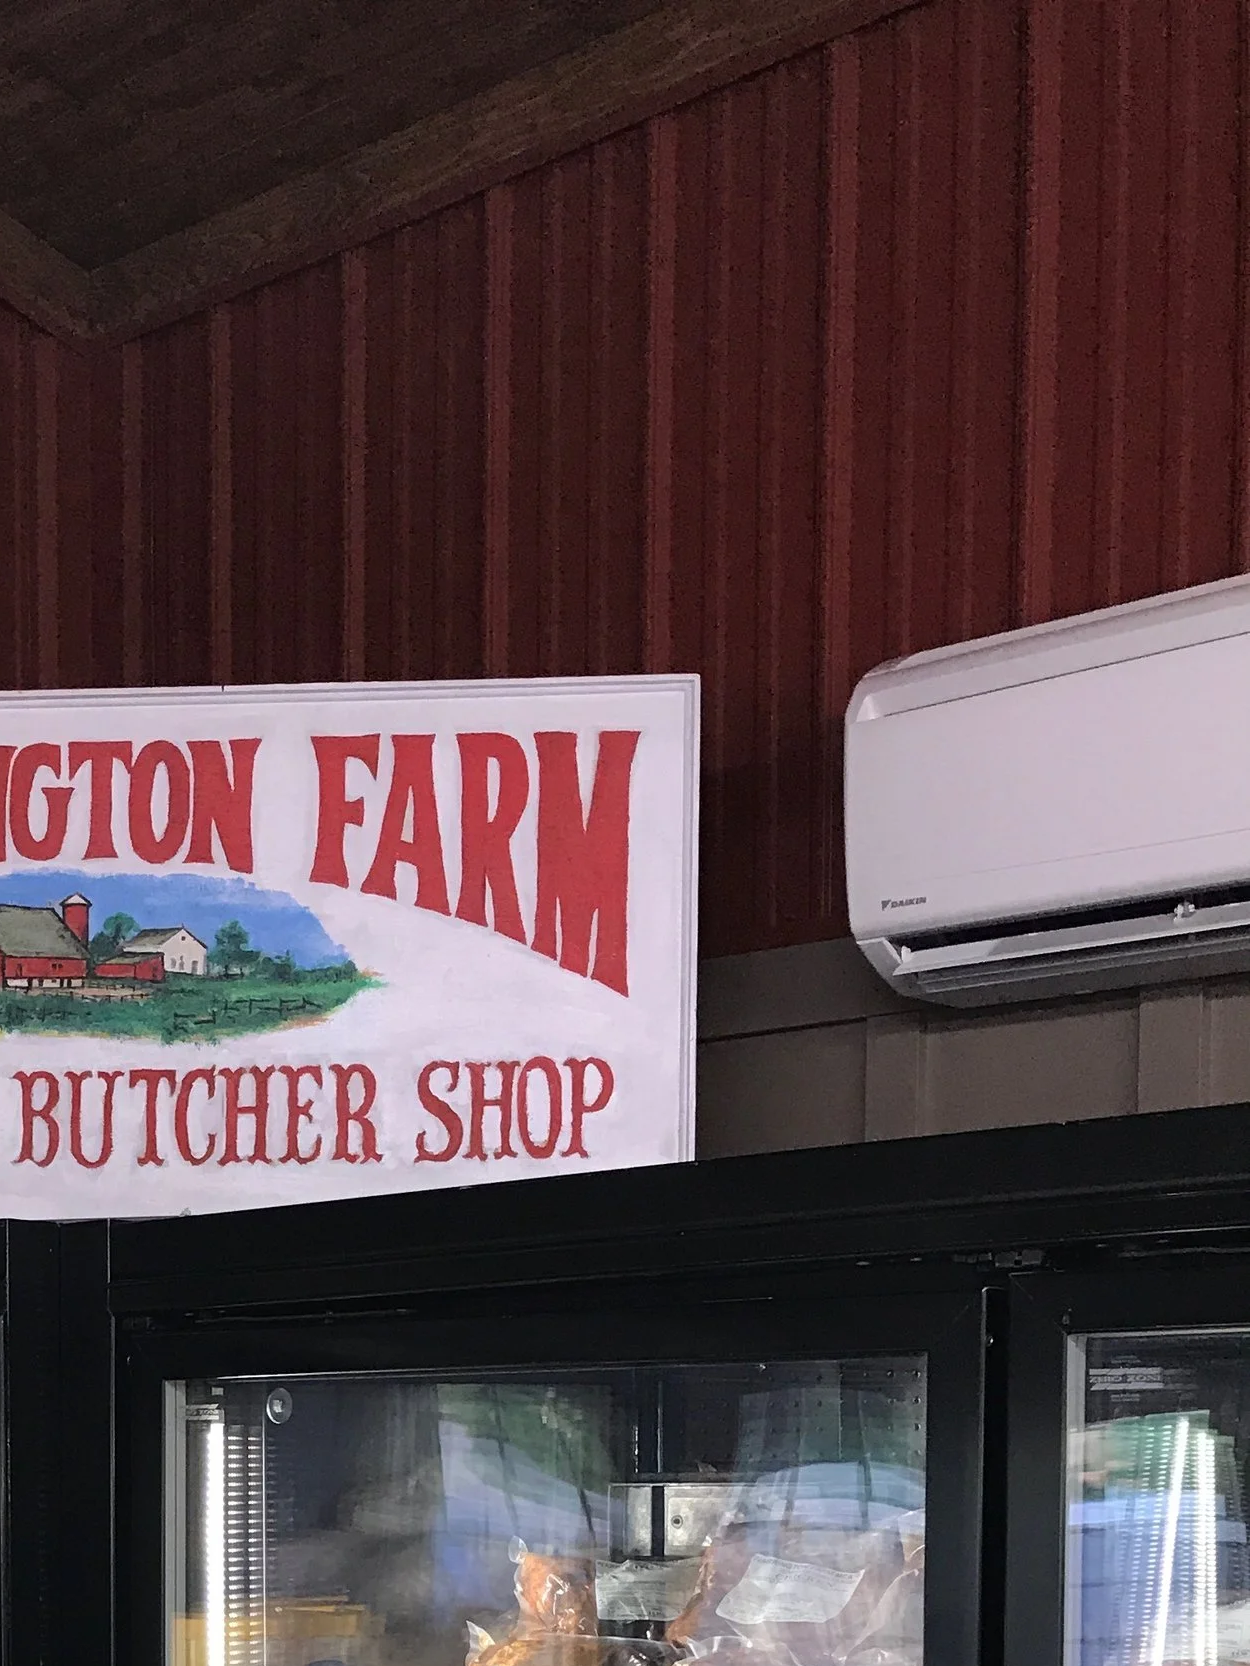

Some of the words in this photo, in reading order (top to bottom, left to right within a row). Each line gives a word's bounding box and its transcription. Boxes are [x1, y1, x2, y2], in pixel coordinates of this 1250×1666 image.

[310, 730, 641, 998] FARM
[17, 1061, 384, 1166] BUTCHER
[414, 1056, 616, 1163] SHOP
